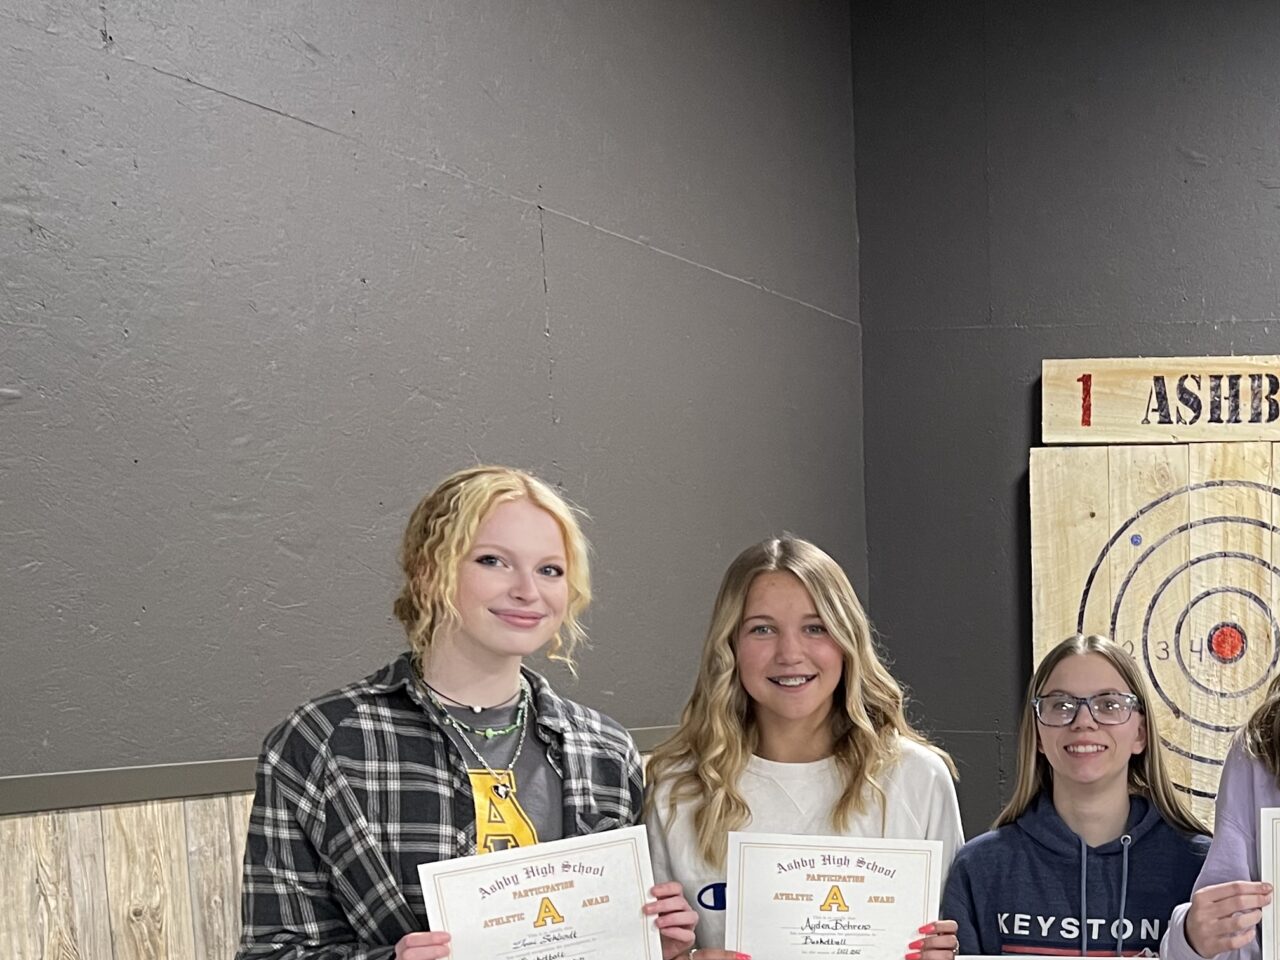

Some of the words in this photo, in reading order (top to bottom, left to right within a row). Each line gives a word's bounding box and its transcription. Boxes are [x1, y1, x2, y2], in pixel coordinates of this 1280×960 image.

[1077, 374, 1092, 426] 1
[1156, 641, 1170, 660] 3
[1190, 637, 1203, 662] 4
[478, 874, 520, 899] Ashby
[523, 863, 555, 879] High
[561, 861, 605, 877] School
[776, 857, 815, 874] Ashby
[820, 854, 850, 867] High
[856, 857, 897, 879] School
[773, 892, 813, 901] ATHLETIC
[819, 885, 849, 912] A
[483, 913, 525, 928] ATHLETIC
[581, 895, 610, 908] AWARD
[533, 897, 565, 928] A
[998, 913, 1160, 941] KEYSTON
